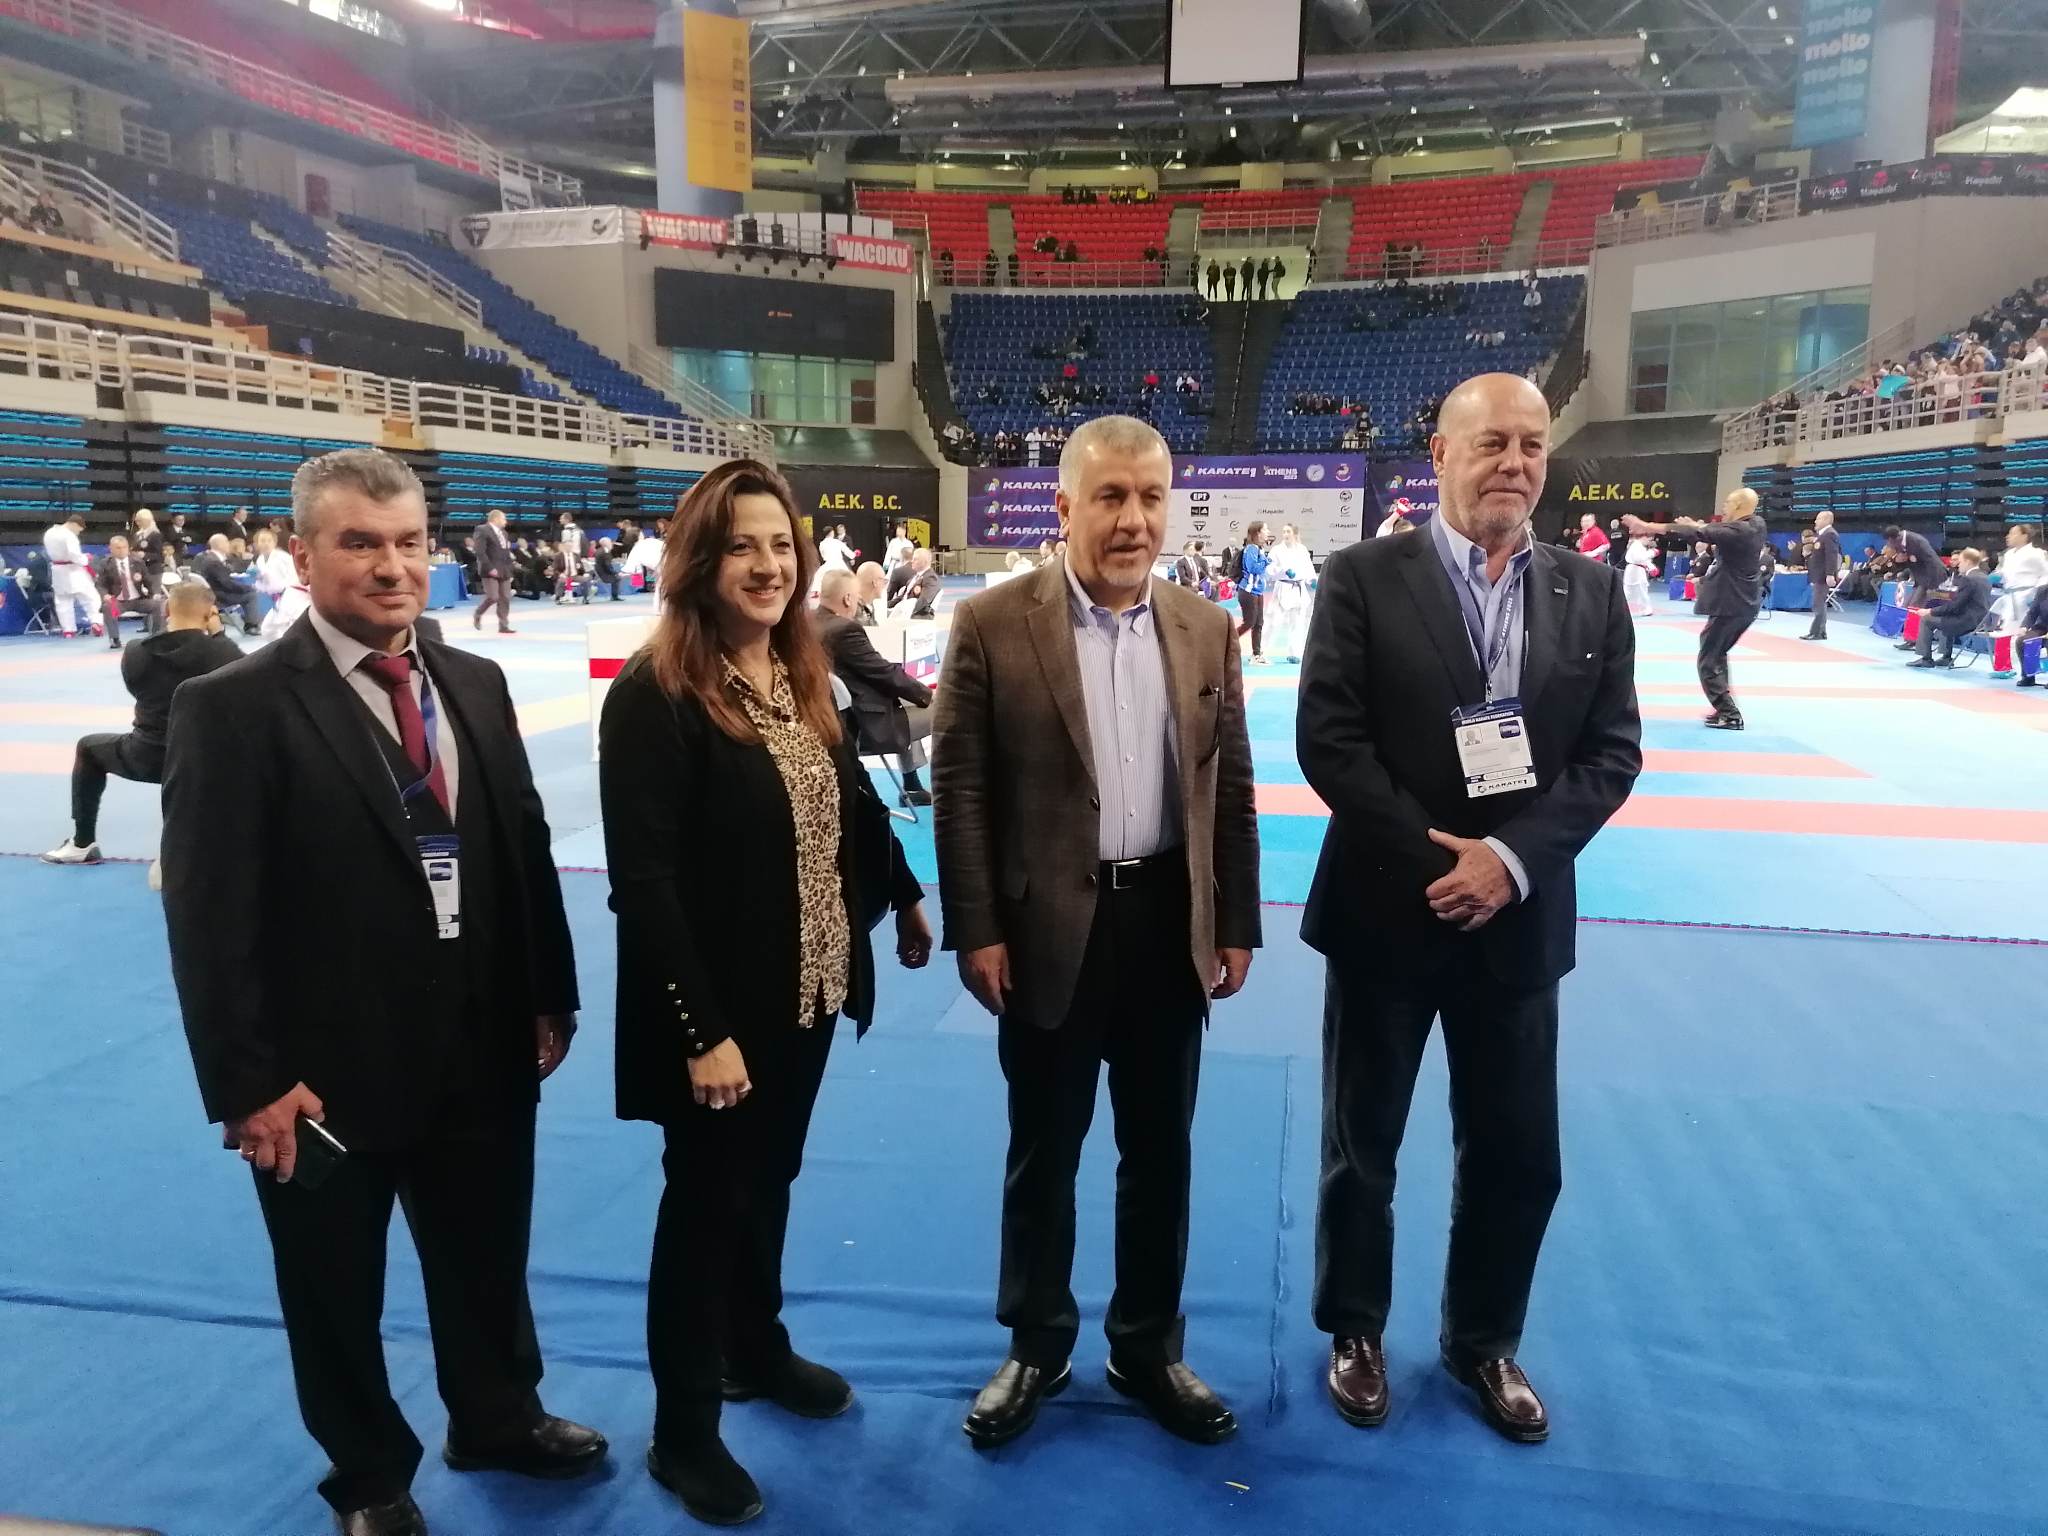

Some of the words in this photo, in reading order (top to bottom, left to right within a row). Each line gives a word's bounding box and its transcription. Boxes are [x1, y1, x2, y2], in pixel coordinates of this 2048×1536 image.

[646, 215, 723, 244] WACOKU
[837, 239, 908, 268] WACOKU
[1197, 467, 1257, 477] KARATE1
[1264, 467, 1298, 476] ATHENS
[1002, 481, 1060, 490] KARATE
[1405, 478, 1439, 487] KAR
[1568, 483, 1625, 501] A.E.K.
[1630, 481, 1670, 500] B.C.
[818, 493, 865, 509] A.E.K.
[873, 494, 902, 510] B.C.
[1002, 504, 1058, 513] KARATE
